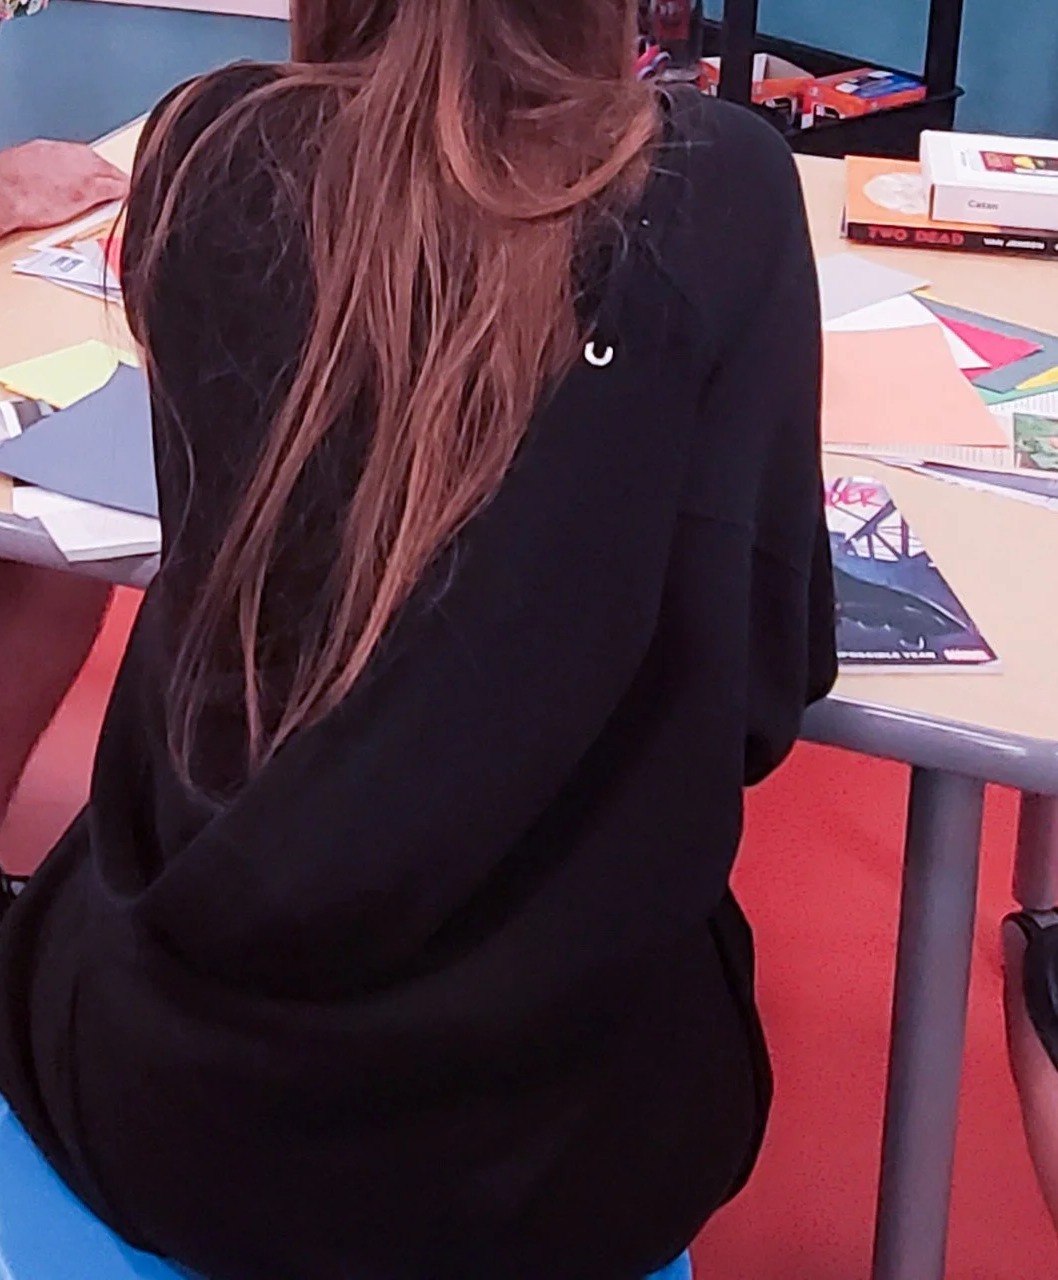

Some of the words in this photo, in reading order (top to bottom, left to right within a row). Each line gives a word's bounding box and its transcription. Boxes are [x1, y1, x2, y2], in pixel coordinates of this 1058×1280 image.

[968, 200, 999, 210] Catan
[868, 226, 908, 241] TWO
[915, 231, 964, 245] DEAD
